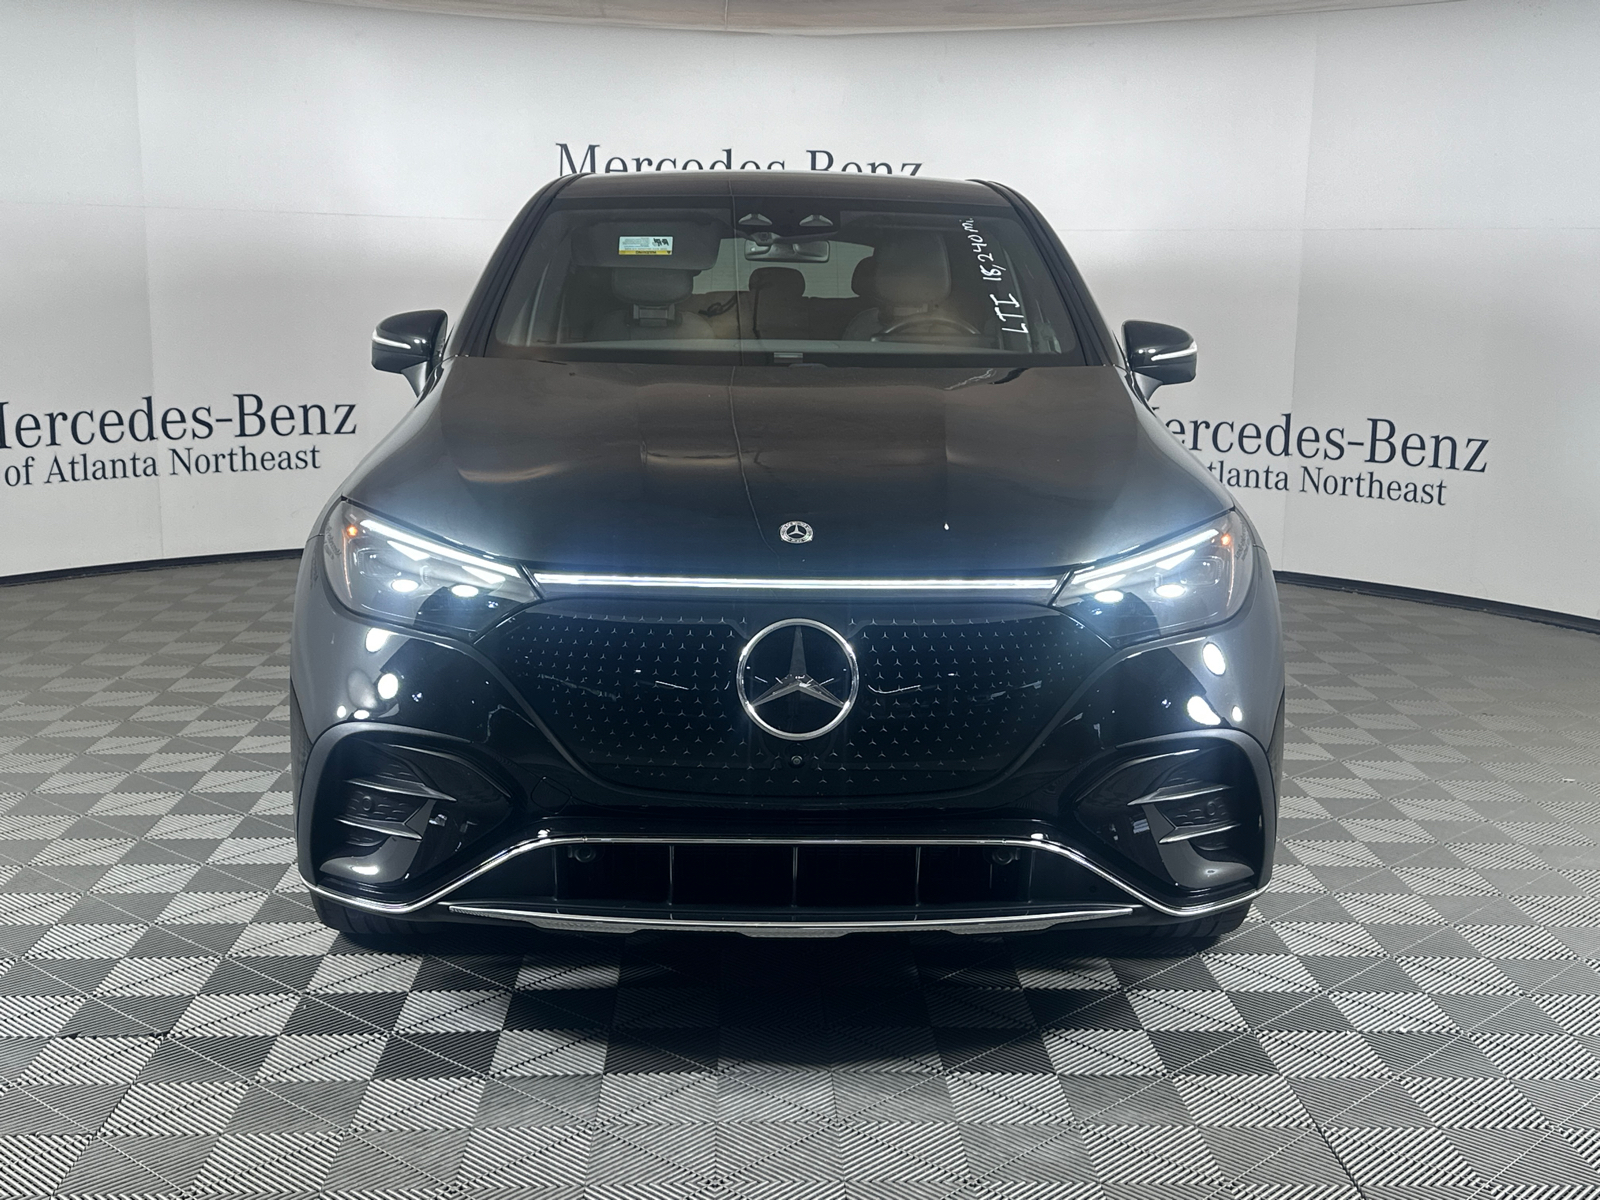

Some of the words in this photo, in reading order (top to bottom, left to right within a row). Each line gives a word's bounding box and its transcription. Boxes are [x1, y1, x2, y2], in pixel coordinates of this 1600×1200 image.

[0, 393, 358, 450] ercedes-Benz
[1151, 406, 1490, 473] rcedes-Benz
[4, 456, 35, 487] of
[44, 452, 159, 484] Atlanta
[169, 445, 321, 476] Northeast
[1207, 459, 1289, 492] lanta
[1299, 466, 1447, 506] Northeast
